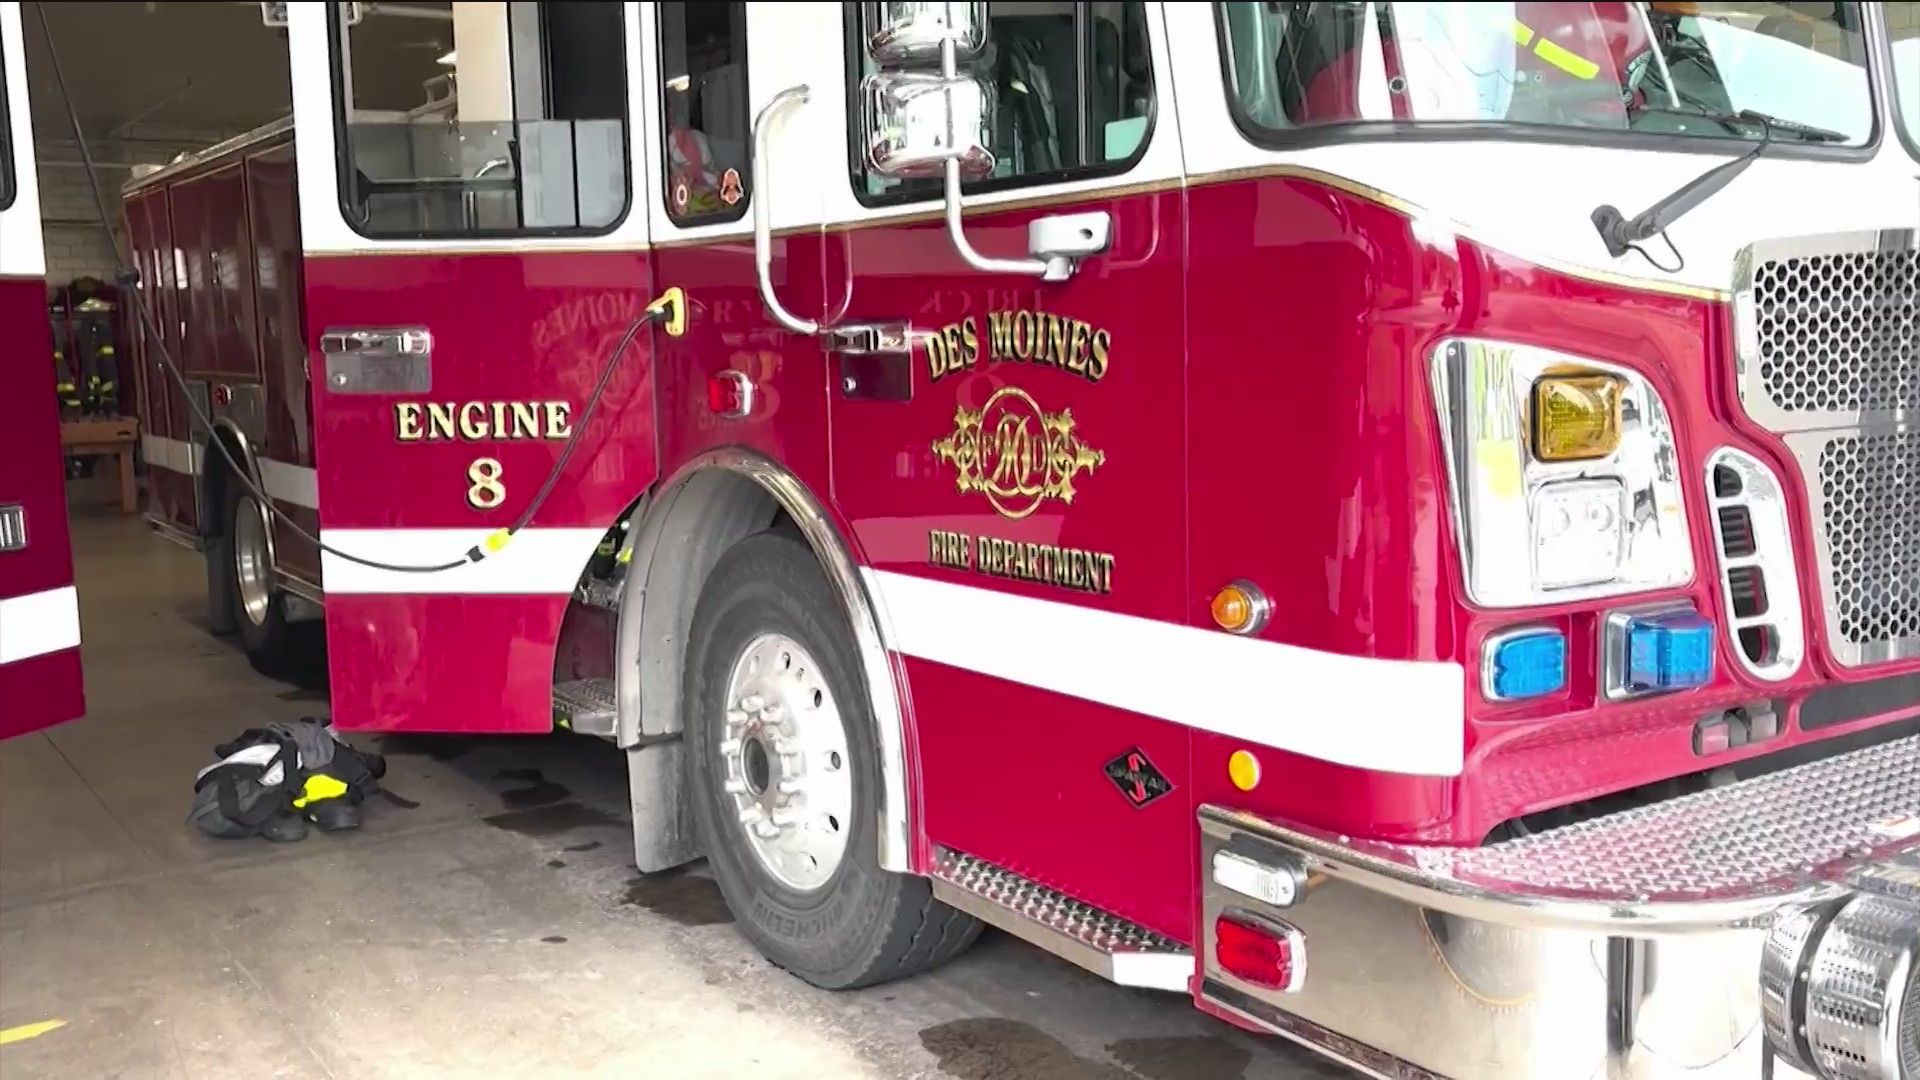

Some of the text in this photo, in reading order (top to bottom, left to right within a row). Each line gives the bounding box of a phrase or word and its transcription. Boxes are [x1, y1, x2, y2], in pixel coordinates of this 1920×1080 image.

[925, 309, 1112, 384] DES MOINES
[396, 402, 572, 440] ENGINE
[466, 457, 508, 508] 8
[928, 530, 1114, 594] FIRE DEPARTMENT
